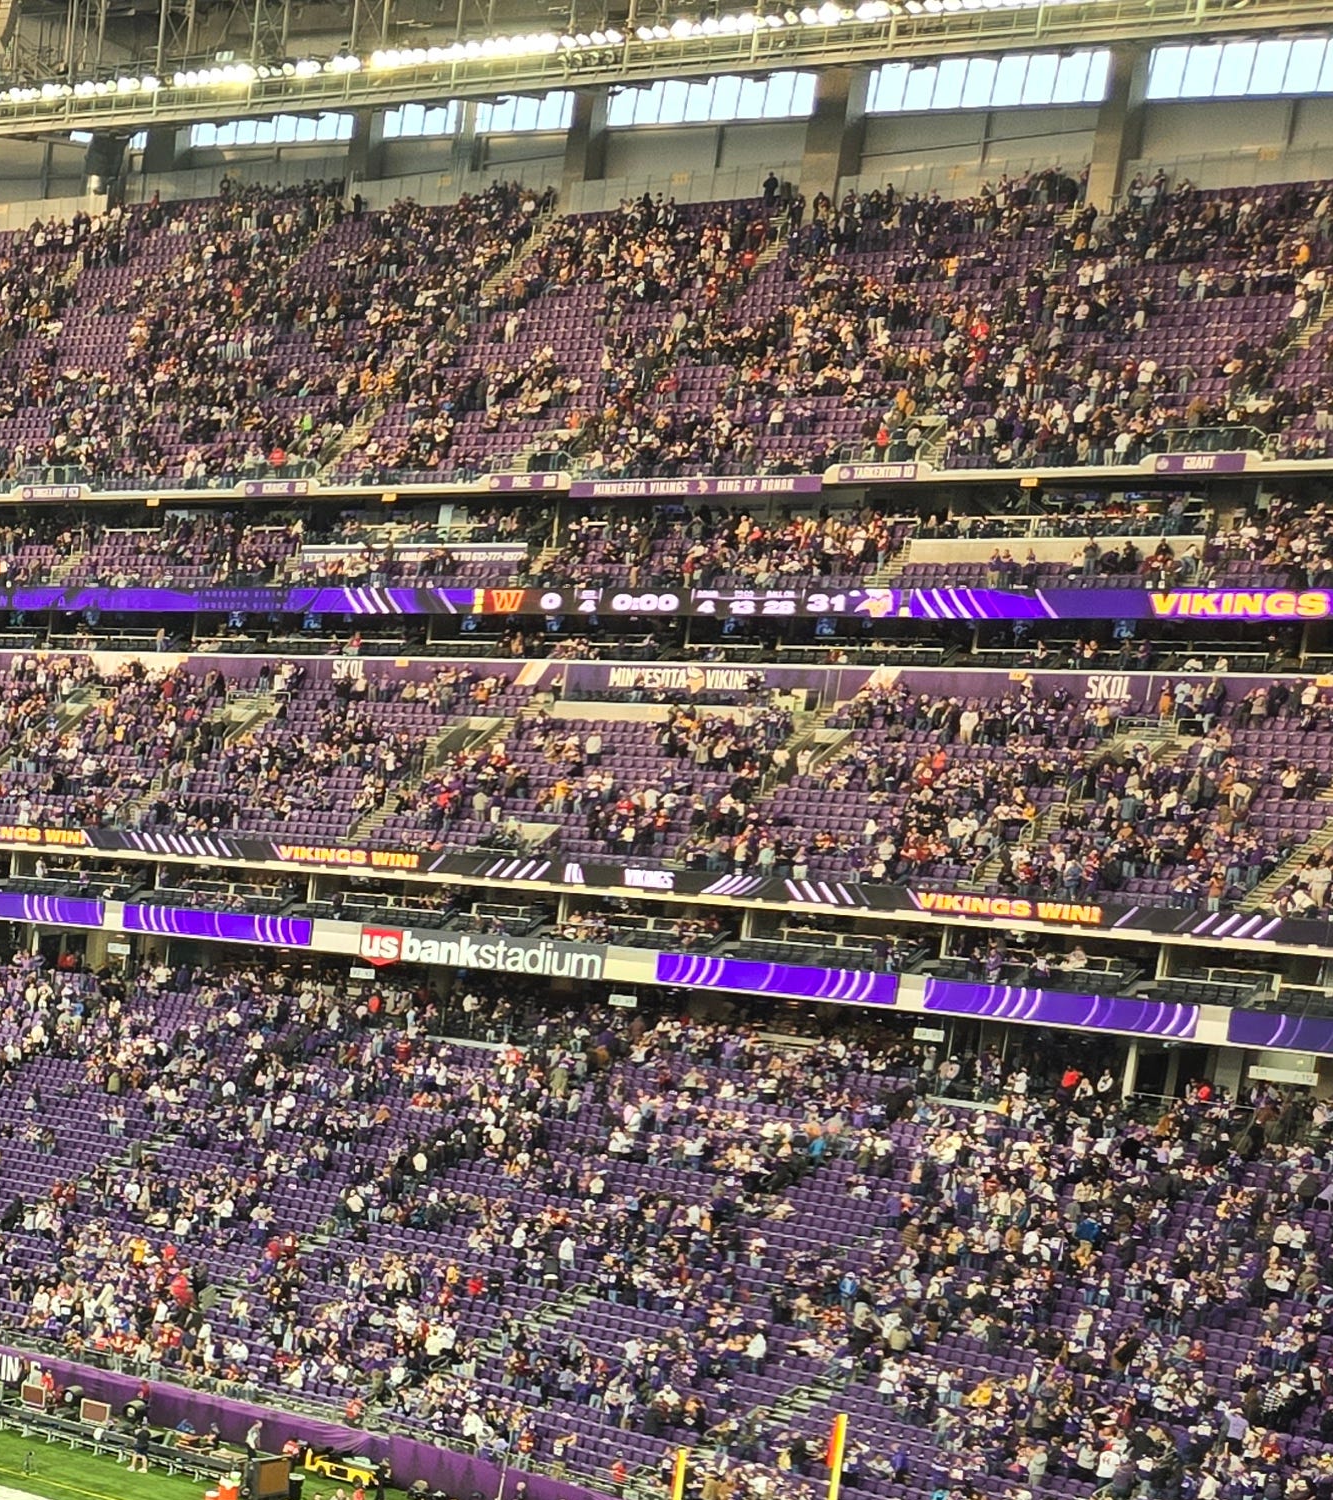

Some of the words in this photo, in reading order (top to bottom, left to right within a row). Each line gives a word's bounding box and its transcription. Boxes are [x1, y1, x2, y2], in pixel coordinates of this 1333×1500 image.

[611, 593, 680, 611] 0:00
[806, 593, 846, 611] 31
[1149, 591, 1331, 618] VIKINGS
[1085, 675, 1132, 700] SKOL
[44, 827, 85, 846] WIN!
[279, 843, 367, 866] VIKINGS
[371, 849, 420, 868] WIN!
[918, 892, 1033, 917] VIKINGS
[1036, 900, 1103, 923] WIN!
